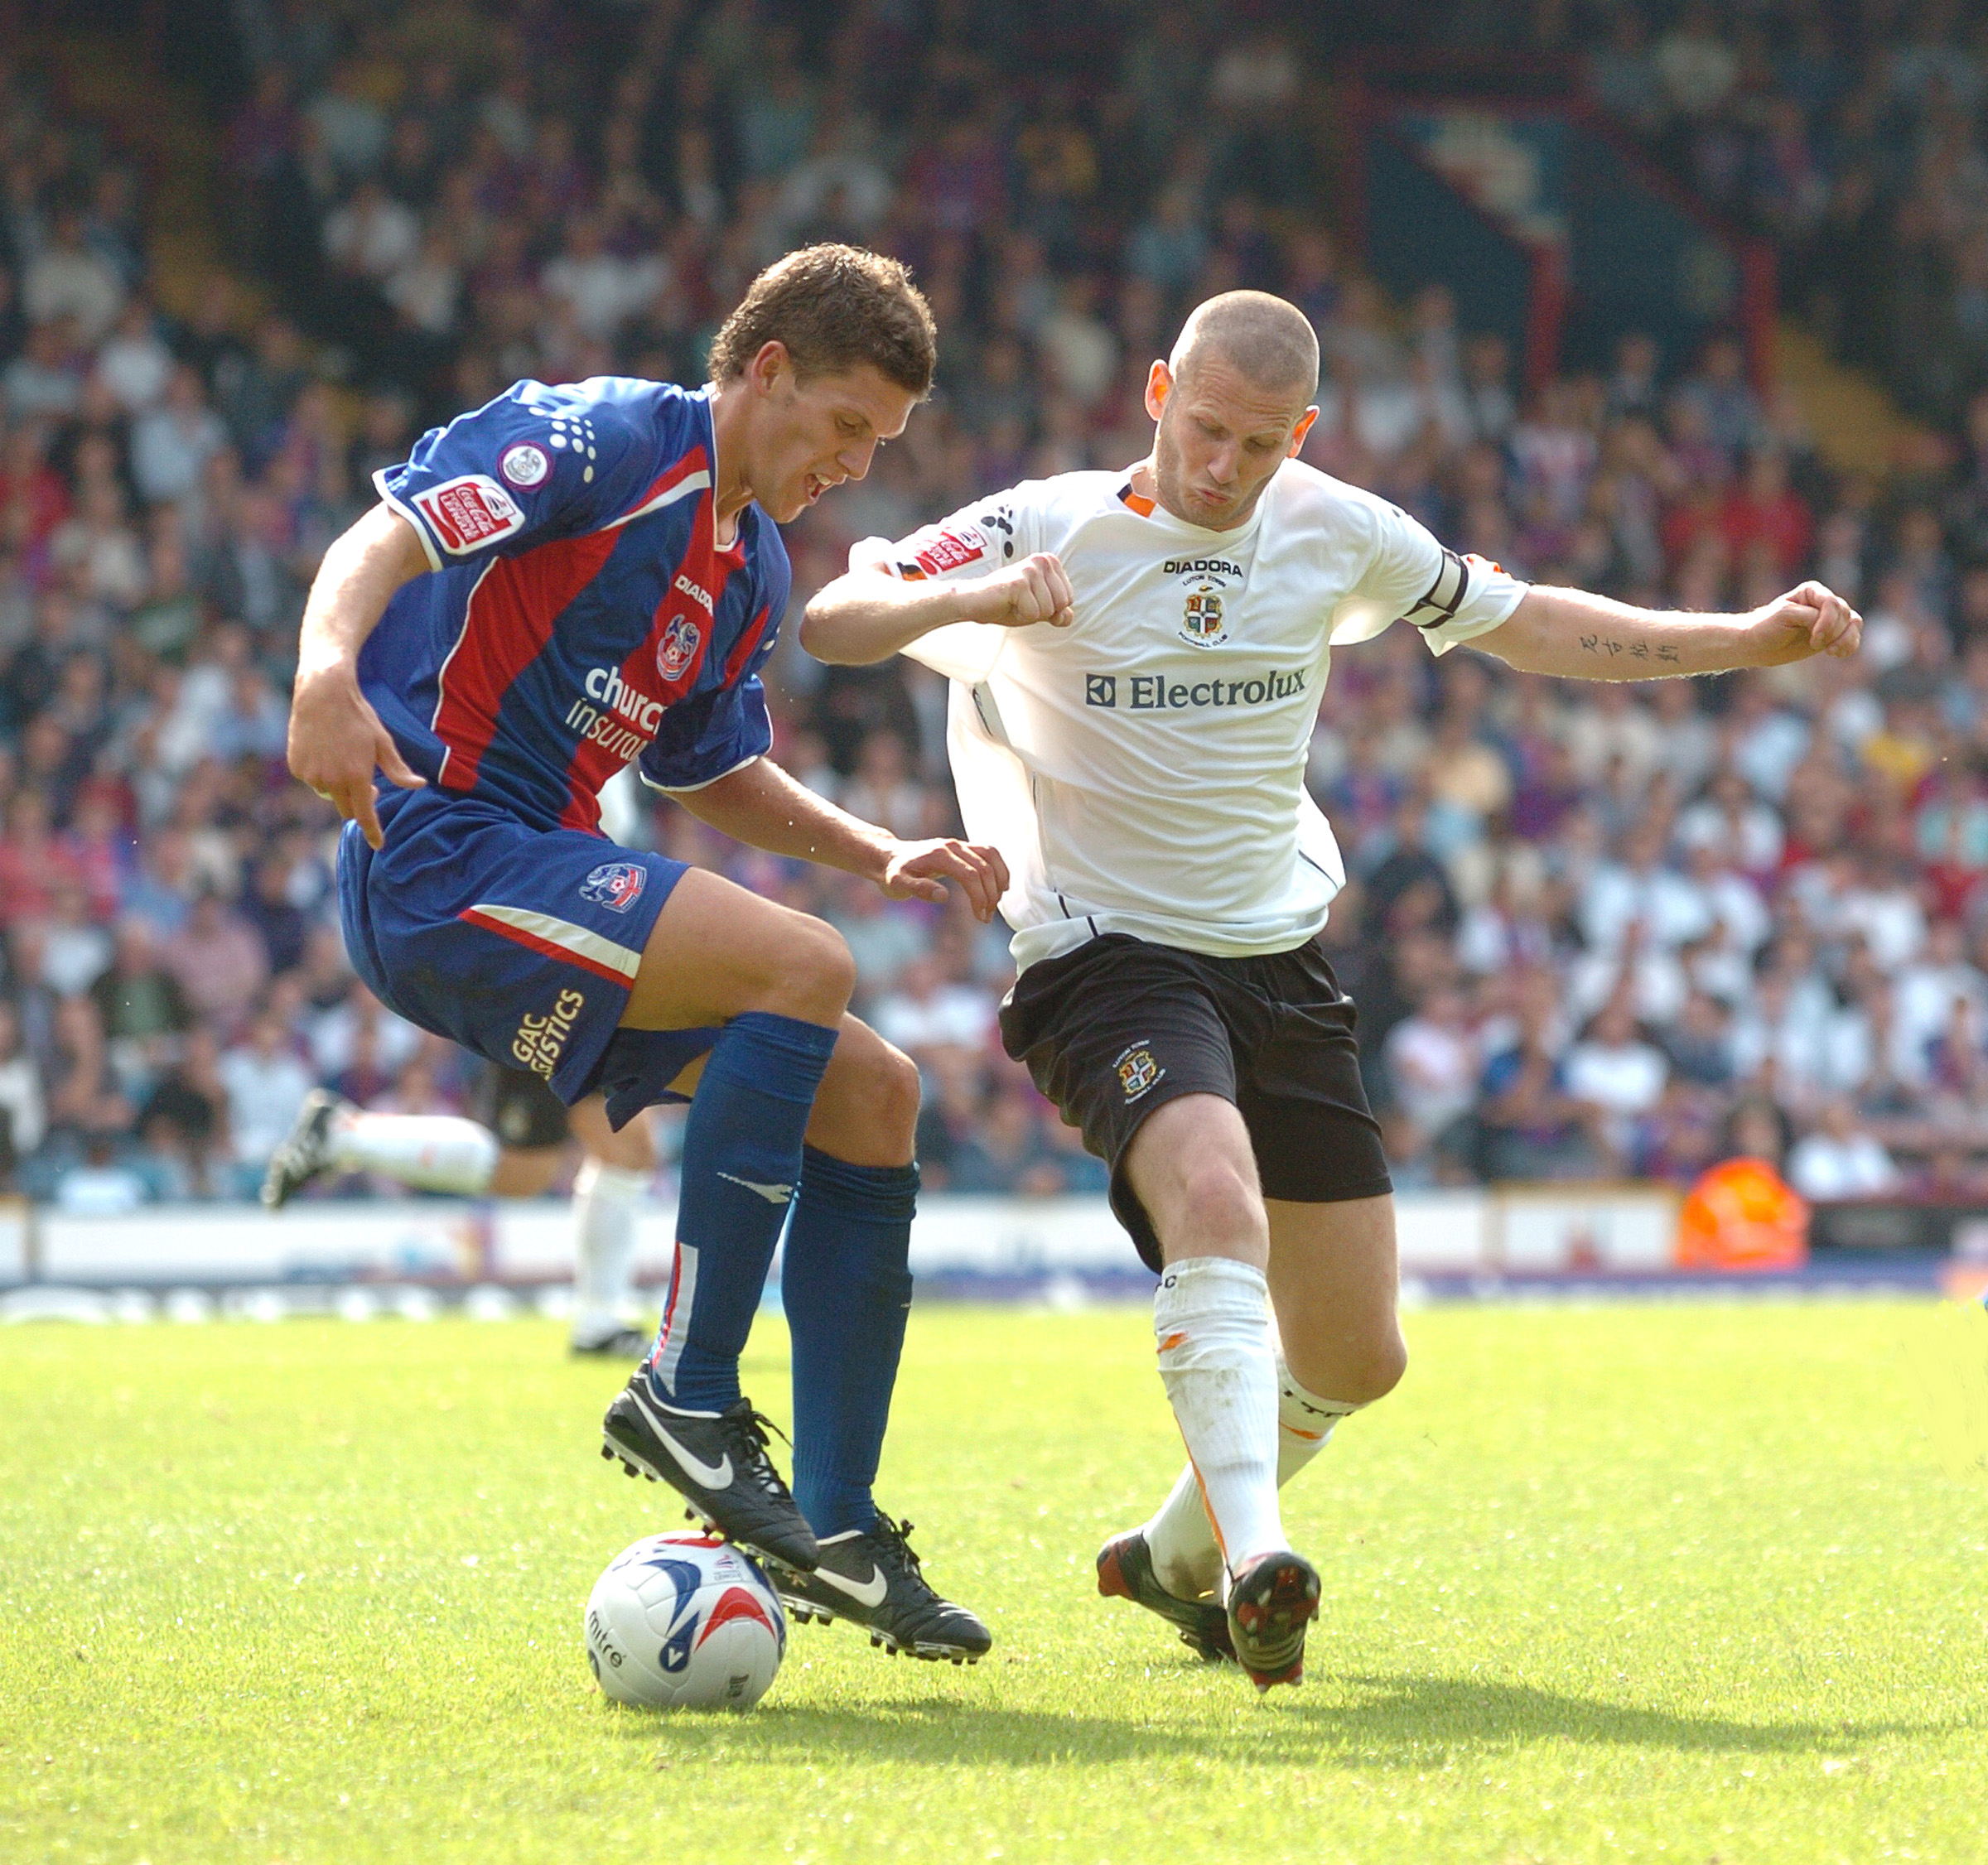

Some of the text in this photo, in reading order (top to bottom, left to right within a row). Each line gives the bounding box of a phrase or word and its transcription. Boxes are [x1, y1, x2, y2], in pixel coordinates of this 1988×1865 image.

[1163, 560, 1243, 578] DIADORA
[1130, 669, 1306, 709] Electrolux
[513, 1013, 548, 1063] GAC
[531, 989, 583, 1081] GISTICS
[589, 1610, 625, 1669] mitre
